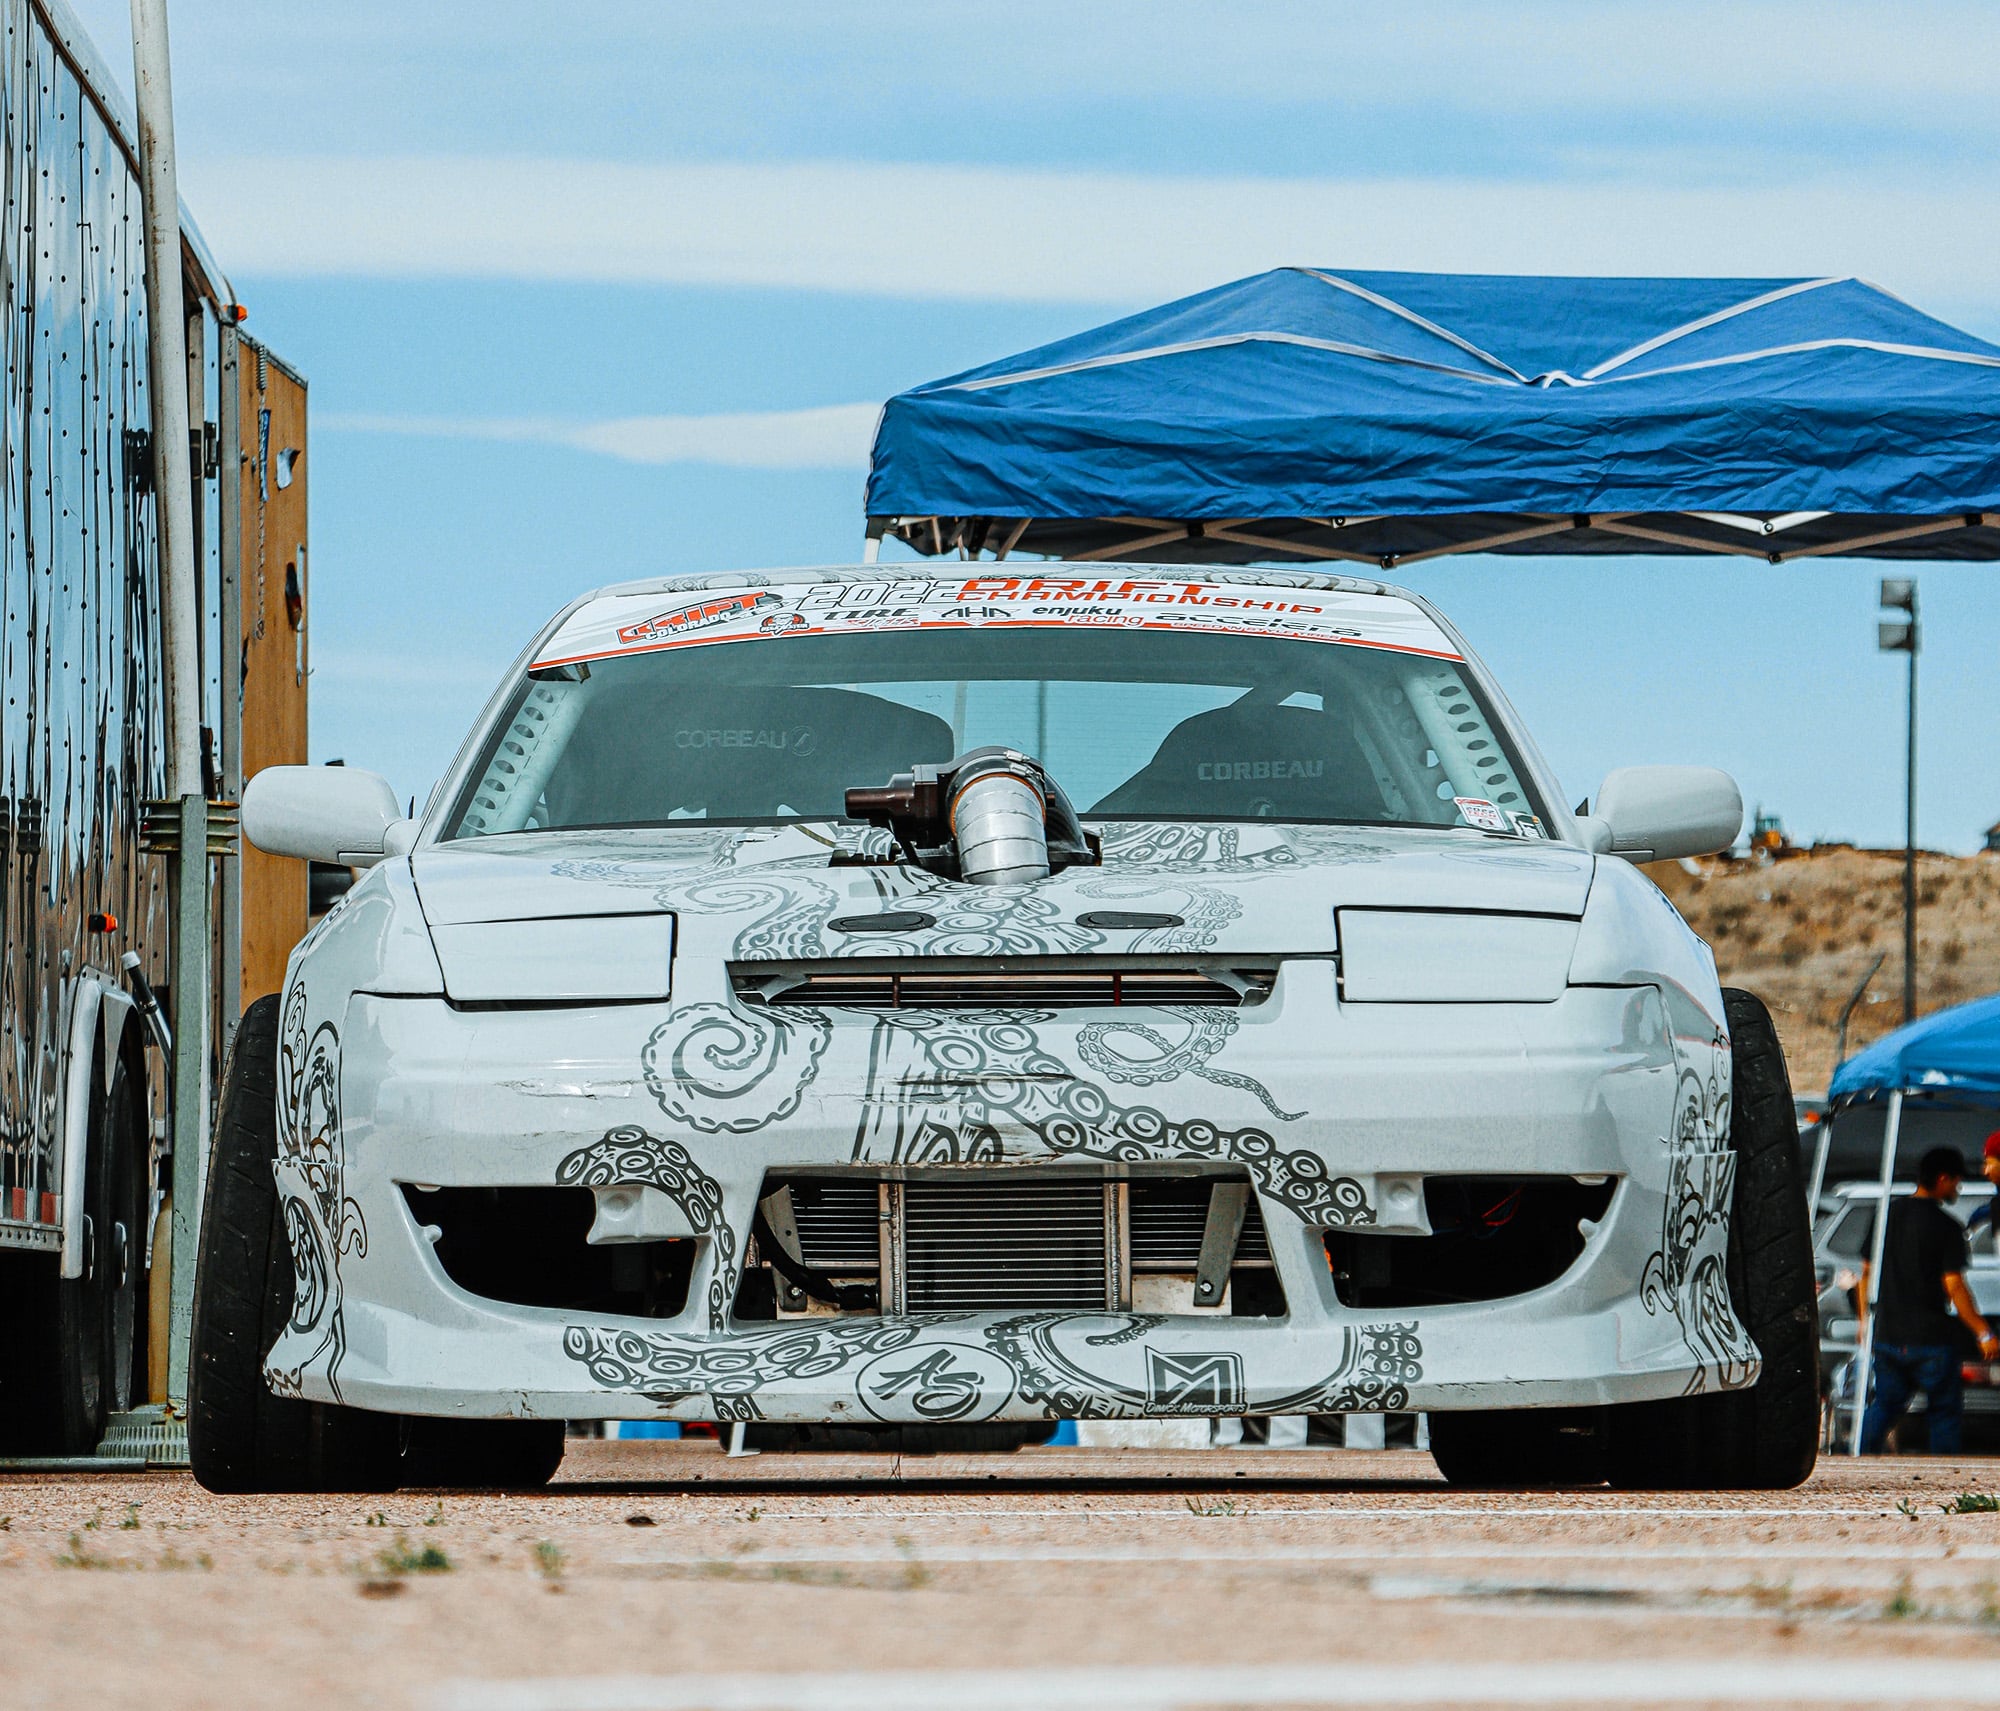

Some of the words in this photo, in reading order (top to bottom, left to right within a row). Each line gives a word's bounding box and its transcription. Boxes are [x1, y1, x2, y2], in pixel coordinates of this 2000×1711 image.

[795, 580, 968, 611] 2022
[961, 579, 1221, 596] DRIFT
[955, 591, 1323, 613] CHAMPIONSHIP
[823, 607, 921, 621] TIRE
[1031, 606, 1123, 617] enjuku
[1067, 612, 1145, 626] racing
[644, 611, 732, 640] COLORADO
[1155, 612, 1363, 638] accelera
[674, 730, 787, 749] CORBEAU
[1198, 760, 1324, 781] CORBEAU
[1180, 1402, 1246, 1414] MOTORSPORTS
